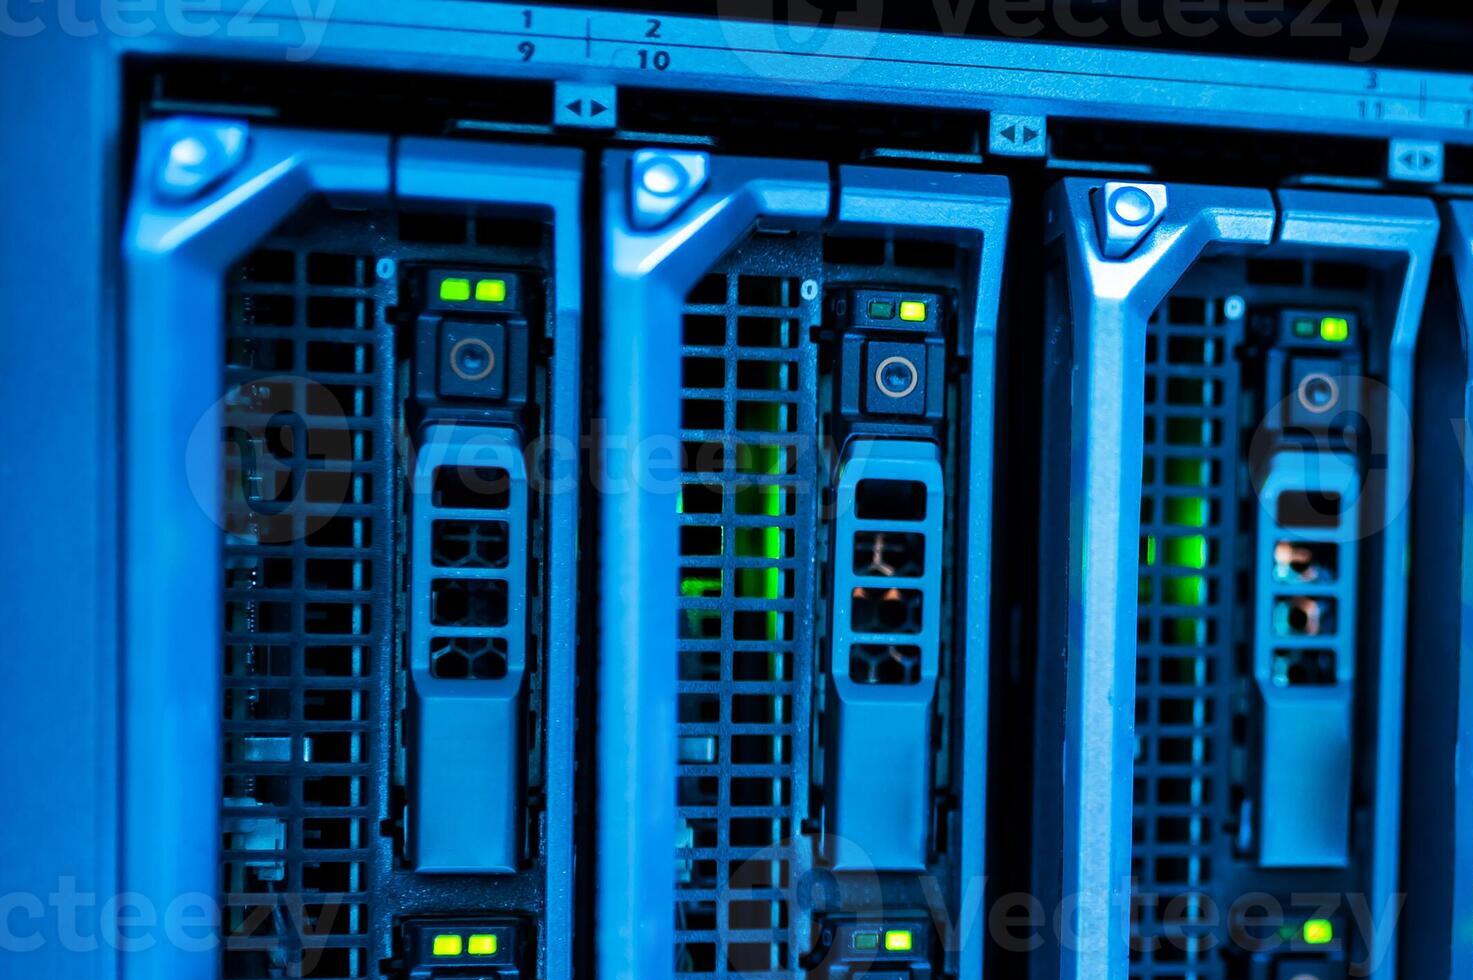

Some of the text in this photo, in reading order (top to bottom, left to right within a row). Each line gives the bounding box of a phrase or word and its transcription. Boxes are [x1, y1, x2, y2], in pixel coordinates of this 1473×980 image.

[522, 10, 532, 29] 1
[645, 19, 662, 38] 2
[517, 41, 535, 62] 9
[638, 50, 670, 71] 10
[1366, 69, 1378, 89] 3
[1358, 101, 1384, 120] 11
